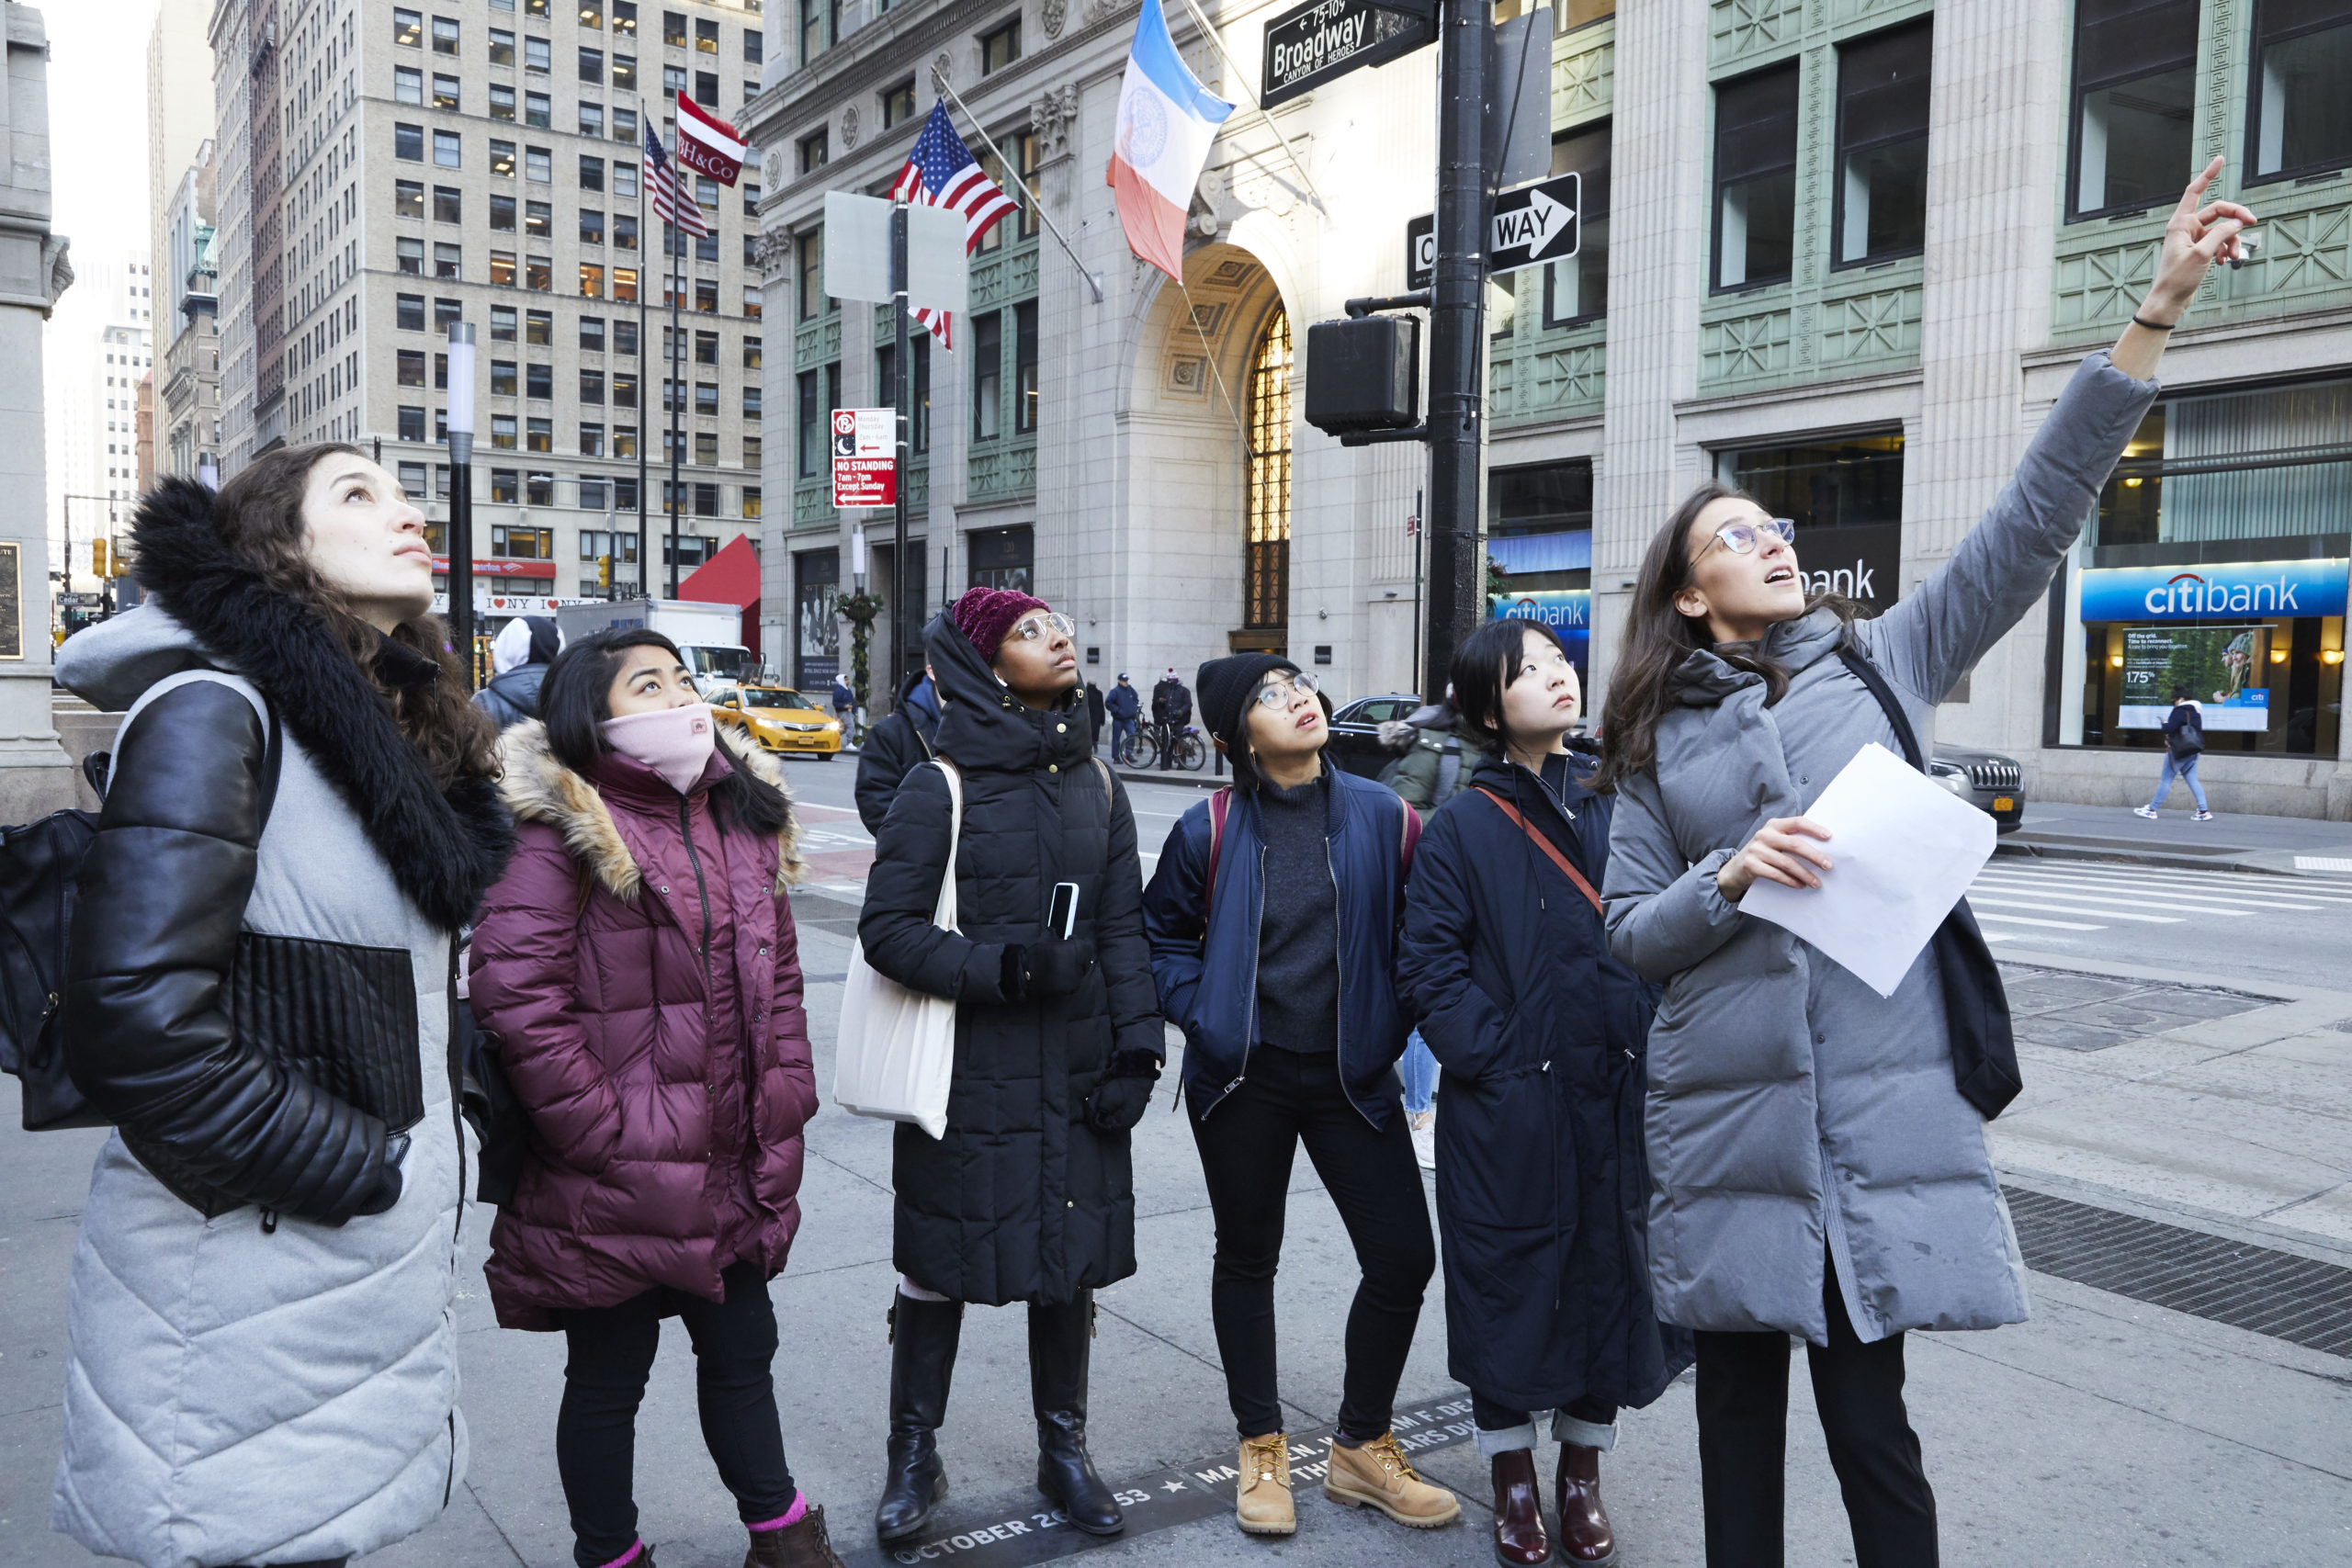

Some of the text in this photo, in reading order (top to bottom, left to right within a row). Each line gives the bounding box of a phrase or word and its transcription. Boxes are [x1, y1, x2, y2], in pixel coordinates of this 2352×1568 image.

[1313, 0, 1346, 27] 75-109
[1274, 10, 1367, 77] Broadway
[1283, 41, 1355, 84] CANYON OF HEROES
[1498, 206, 1553, 247] WAY
[837, 460, 894, 471] NO STANDING
[837, 473, 852, 481] 7am
[856, 472, 872, 482] 7pm
[837, 481, 885, 491] Except Sunday
[59, 595, 79, 604] Cedar
[2145, 574, 2299, 613] citibank
[2251, 693, 2264, 701] citi
[1195, 1465, 1239, 1484] MA
[1288, 1443, 1325, 1461] EN.
[1414, 1410, 1443, 1423] F.
